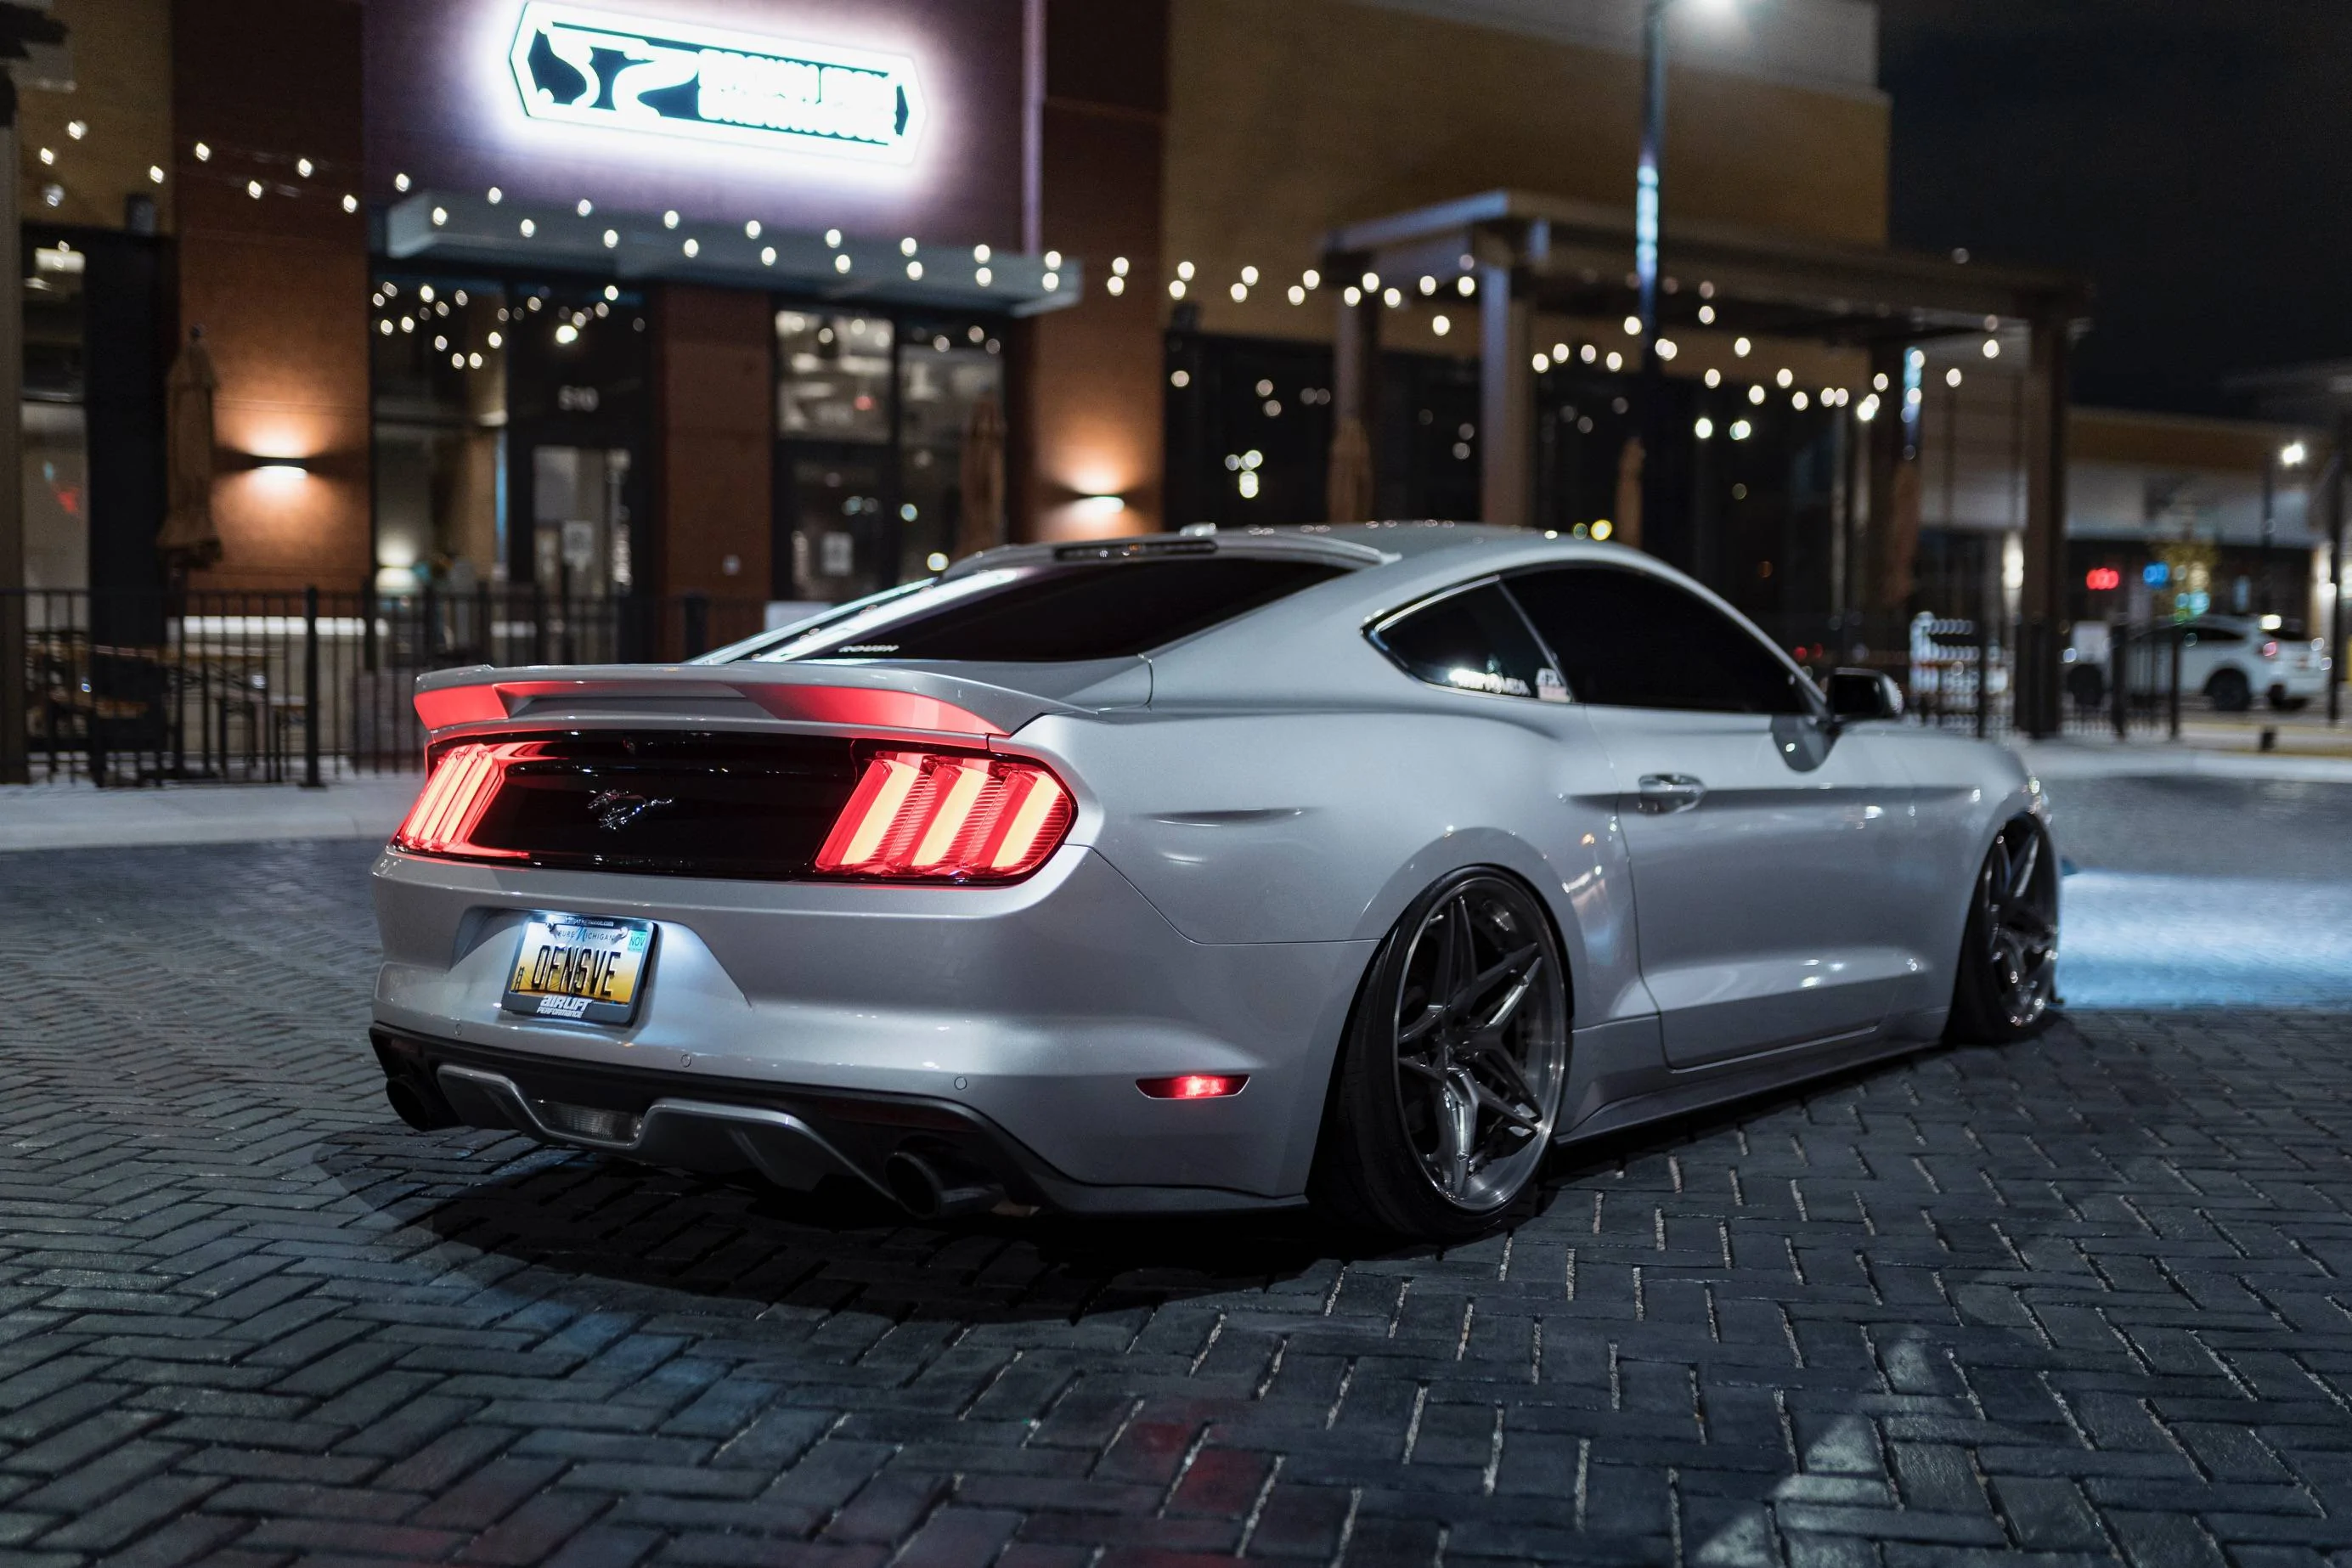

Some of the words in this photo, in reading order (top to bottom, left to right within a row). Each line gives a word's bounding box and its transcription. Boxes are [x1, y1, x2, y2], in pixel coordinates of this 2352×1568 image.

[558, 929, 575, 939] PURE
[577, 924, 614, 942] MICHIGAN
[629, 936, 646, 946] NOV
[531, 945, 621, 996] OFNSVE
